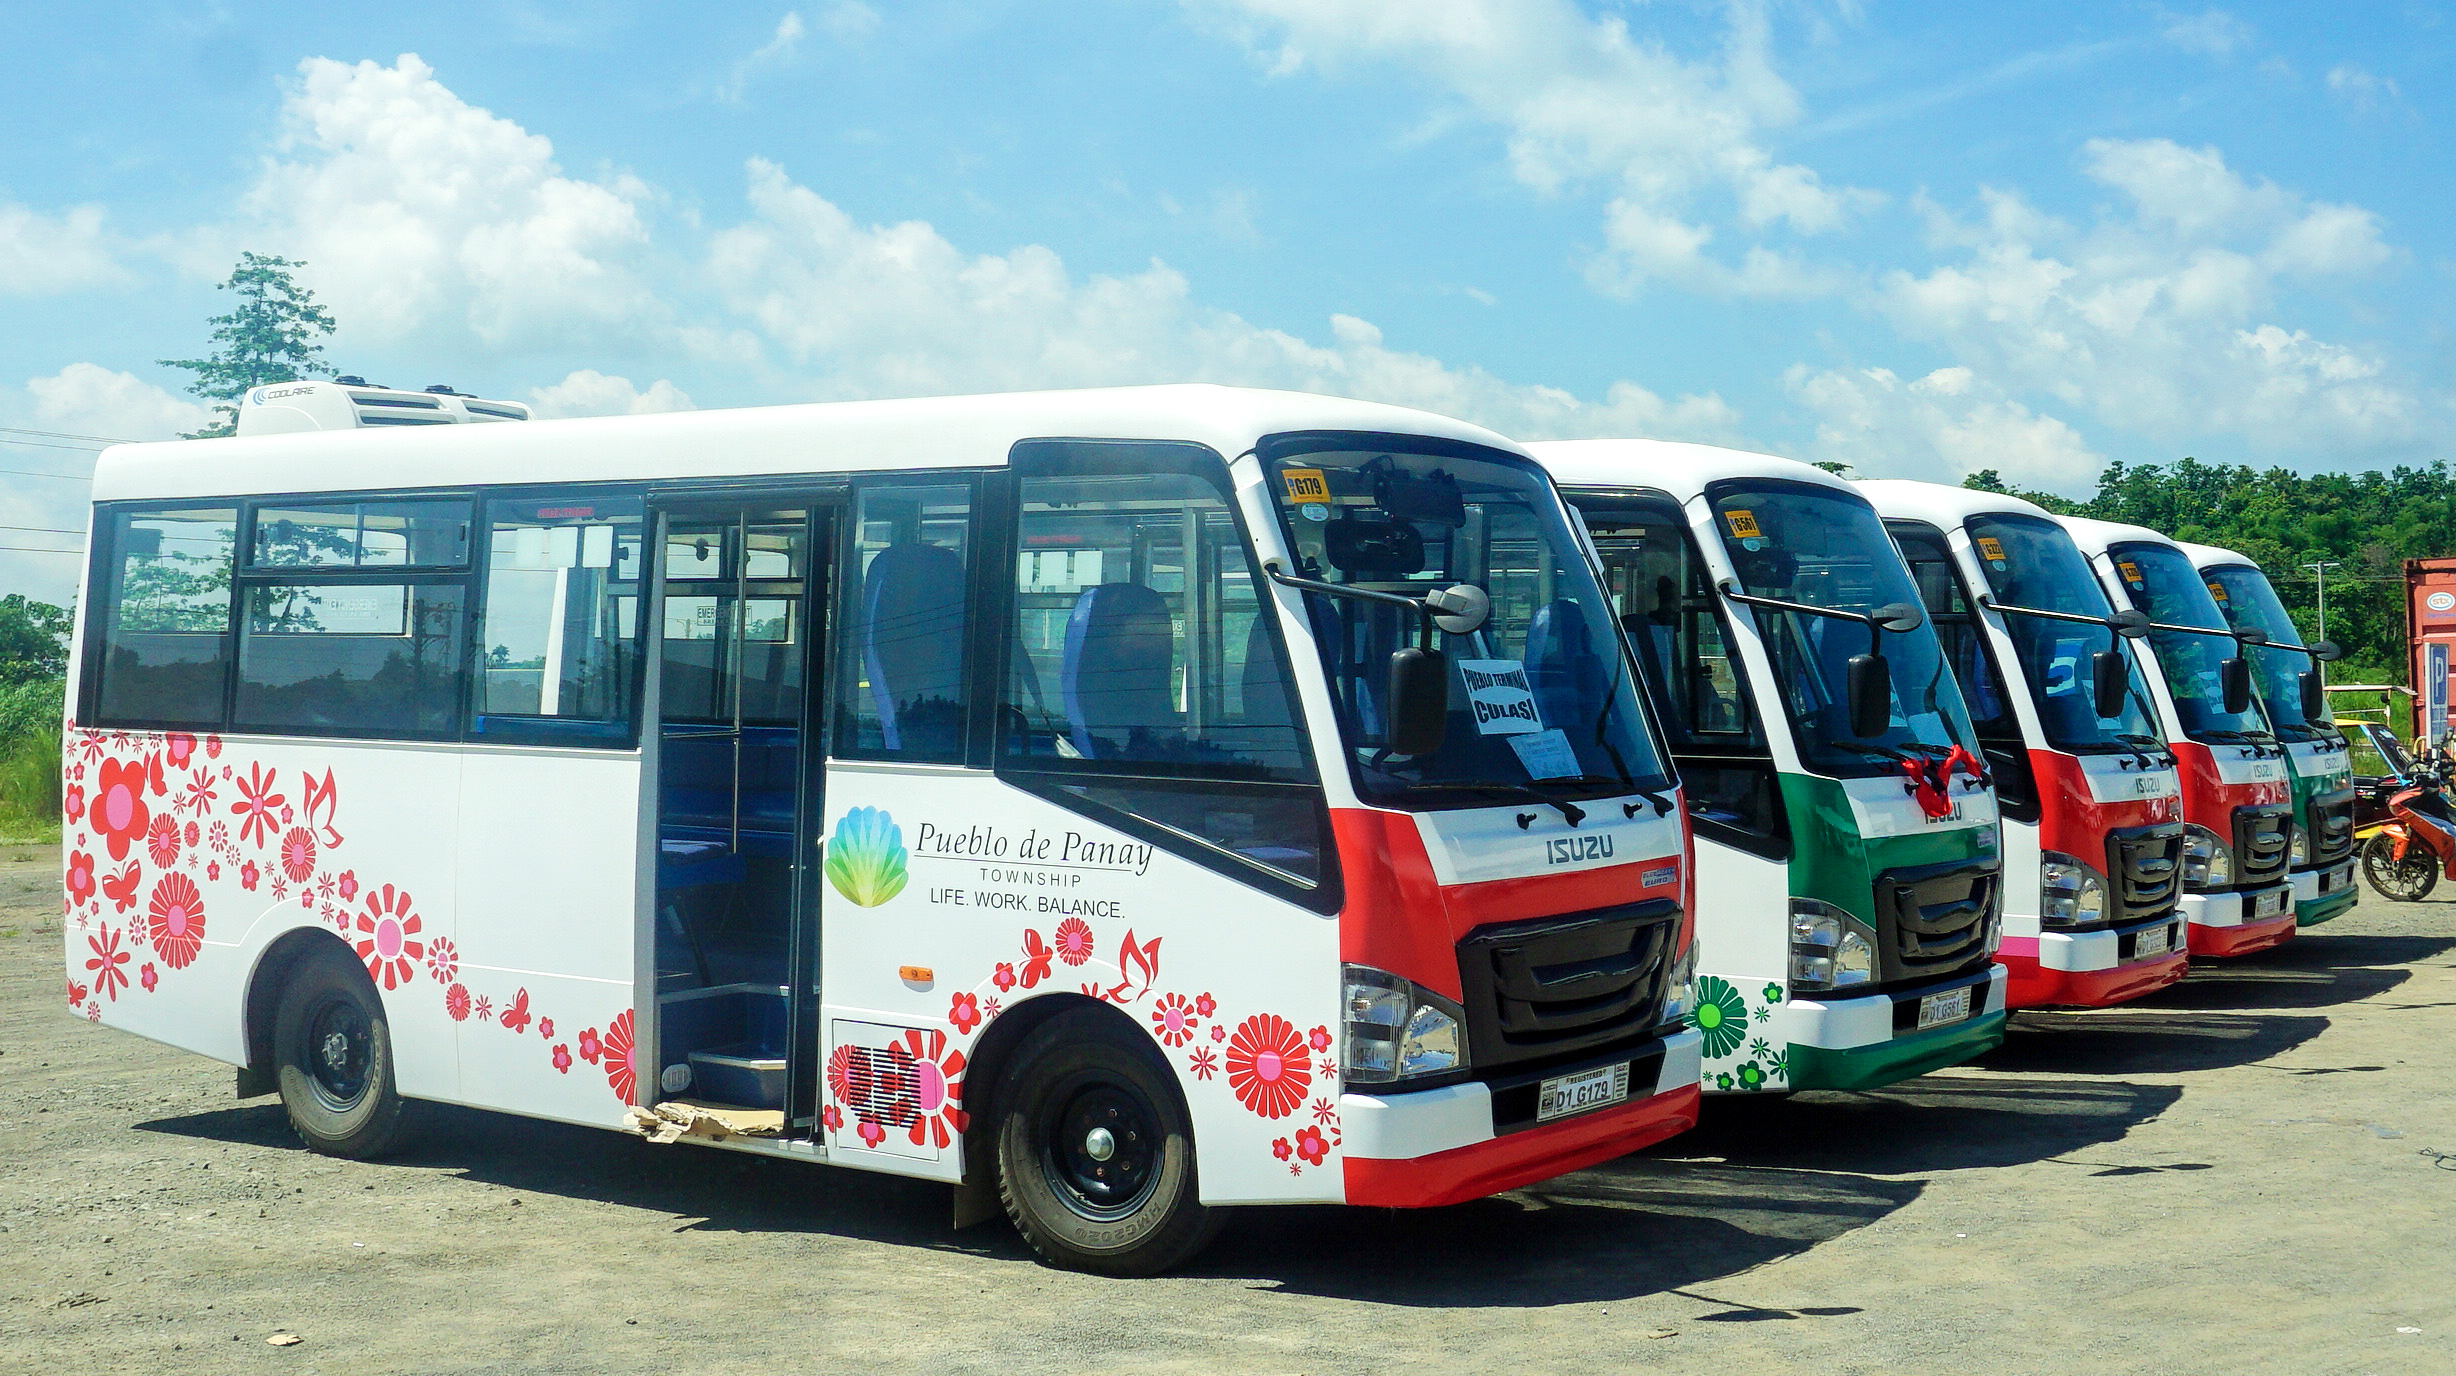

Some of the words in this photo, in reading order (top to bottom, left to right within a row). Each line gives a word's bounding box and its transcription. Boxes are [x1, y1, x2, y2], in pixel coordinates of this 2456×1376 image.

[1294, 477, 1323, 495] G179
[1462, 667, 1494, 693] PUEBLO
[1492, 668, 1531, 693] TERMINAL
[1474, 697, 1539, 724] CULASI
[2135, 776, 2161, 794] ISUZU
[915, 822, 1009, 858] Pueblo
[1019, 828, 1051, 860] de
[1060, 831, 1154, 877] Panay
[1546, 834, 1614, 865] ISUZU
[980, 868, 1082, 888] TOWNSHIP
[930, 887, 969, 907] LIFE.
[975, 891, 1032, 912] WORK.
[1038, 896, 1126, 919] BALANCE.
[1556, 1089, 1573, 1109] D1
[1577, 1080, 1609, 1104] G179
